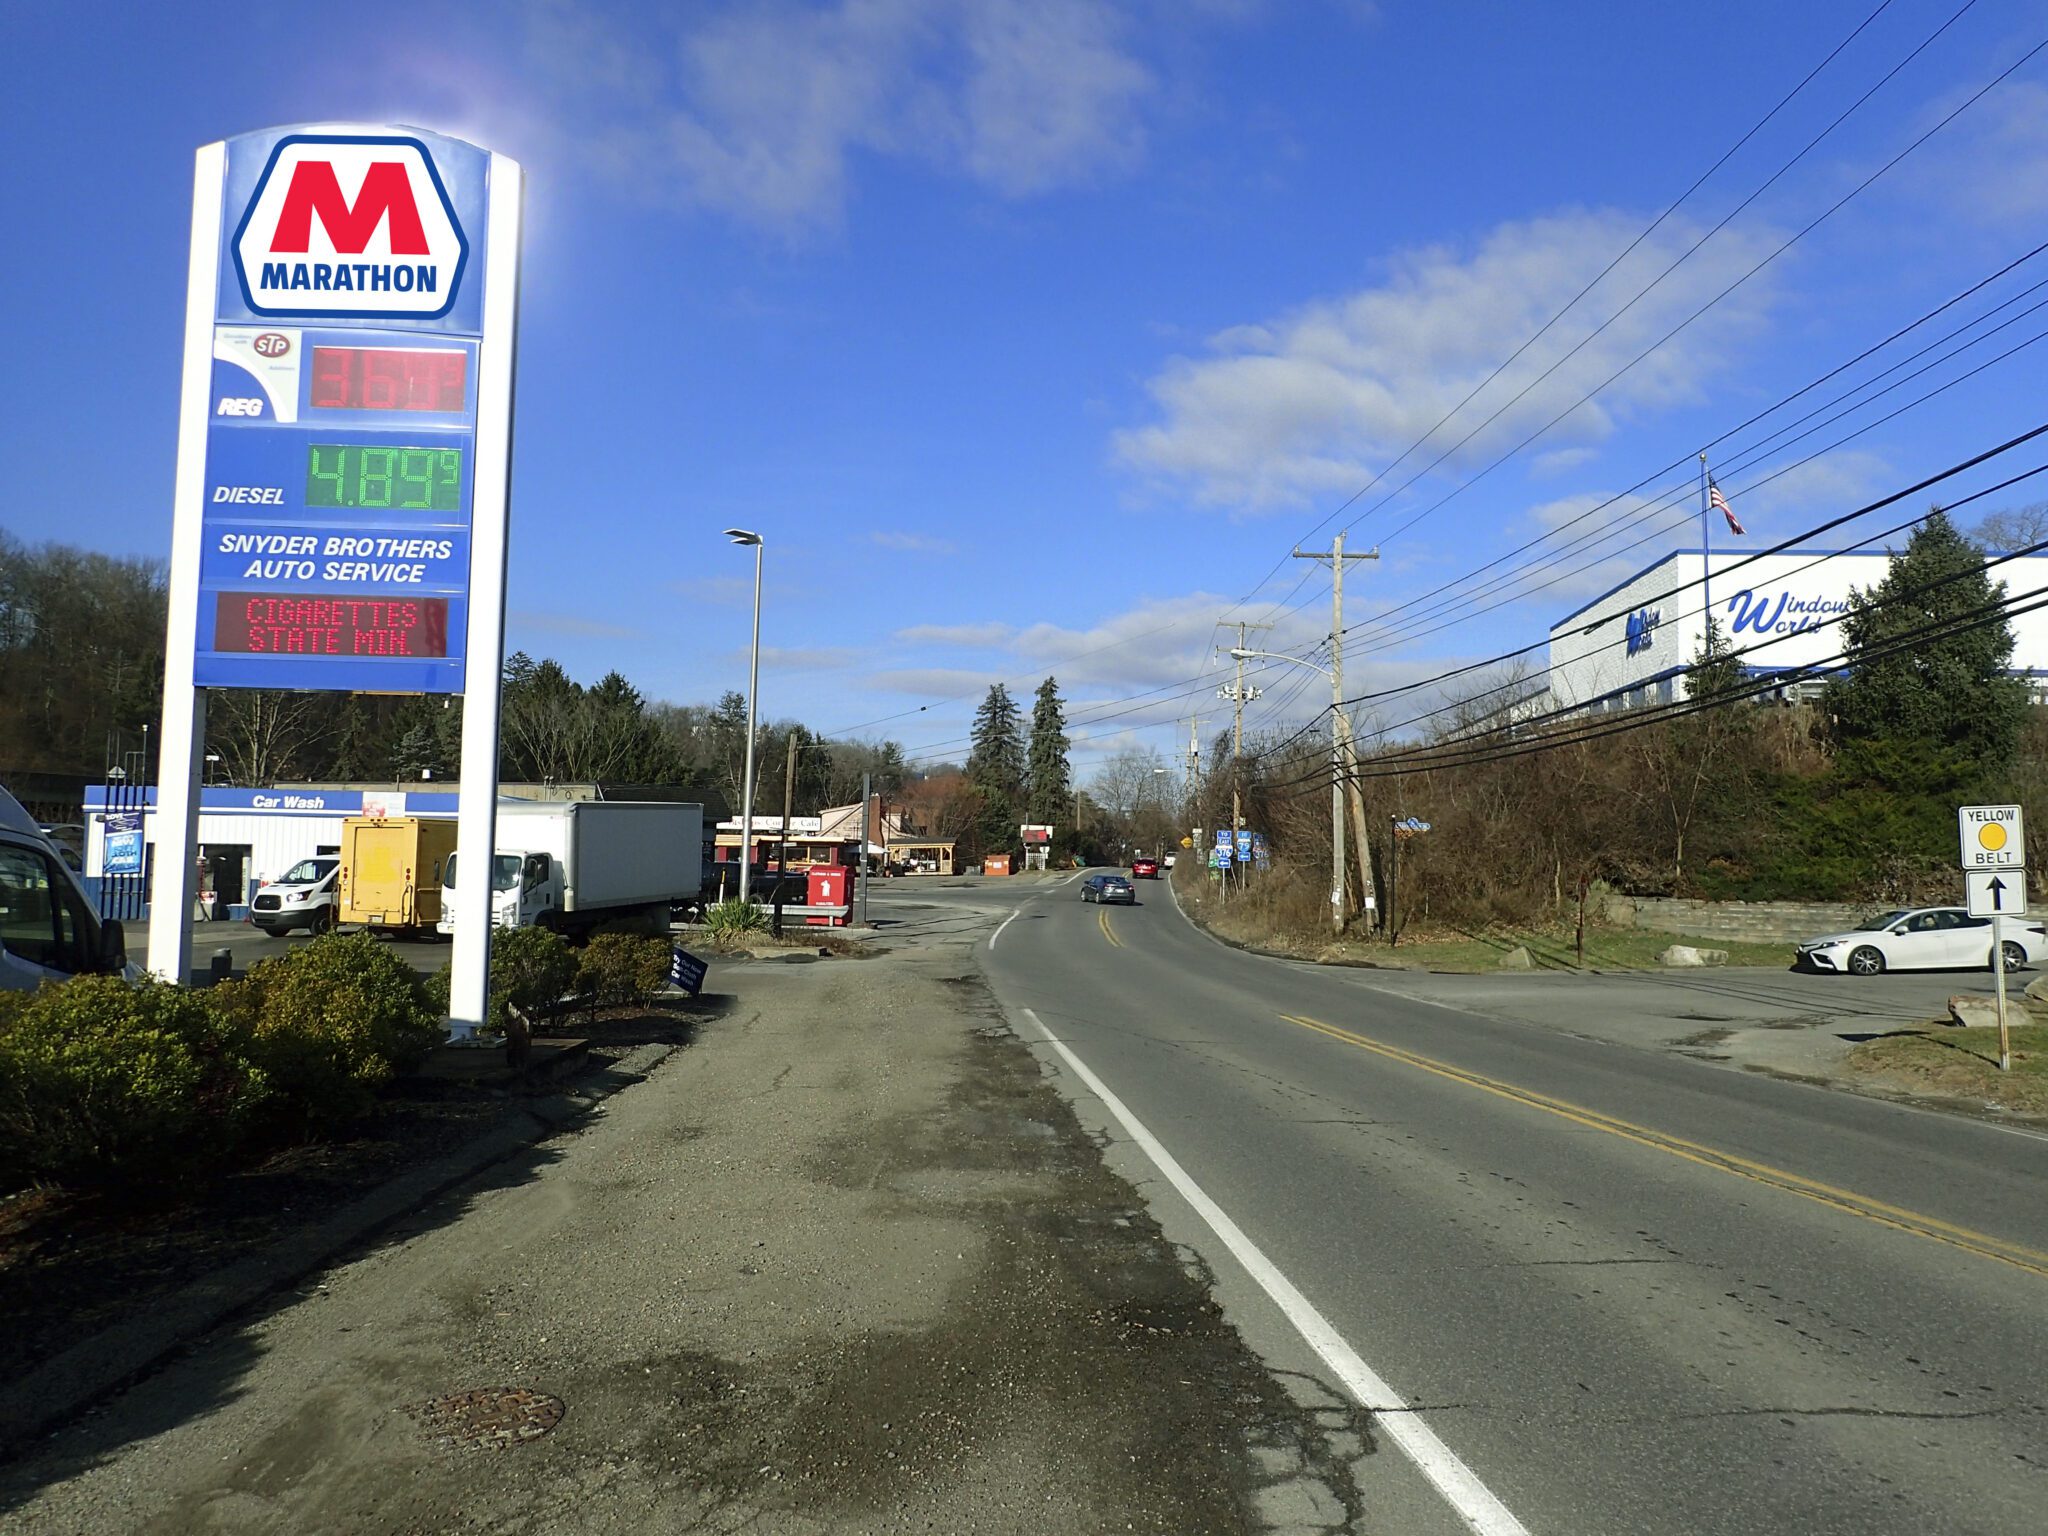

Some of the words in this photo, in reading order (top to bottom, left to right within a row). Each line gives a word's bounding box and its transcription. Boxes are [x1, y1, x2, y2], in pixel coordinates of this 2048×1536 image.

[269, 161, 431, 255] M
[260, 263, 437, 293] MARATHON
[256, 335, 287, 354] STP
[217, 398, 264, 416] REG
[213, 487, 285, 505] DIESEL
[219, 534, 318, 555] SNYDER
[323, 537, 453, 560] BROTHERS
[244, 560, 315, 579] AUTO
[323, 562, 426, 582] SERVICE
[246, 599, 418, 627] CIGARETTES
[1728, 589, 1849, 634] Window
[249, 626, 340, 653] STATE
[354, 629, 413, 655] MIN.
[252, 794, 281, 808] Car
[284, 796, 325, 809] Wash
[1968, 810, 2014, 822] YELLOW
[1238, 842, 1249, 850] 79
[1976, 852, 2011, 864] BELT
